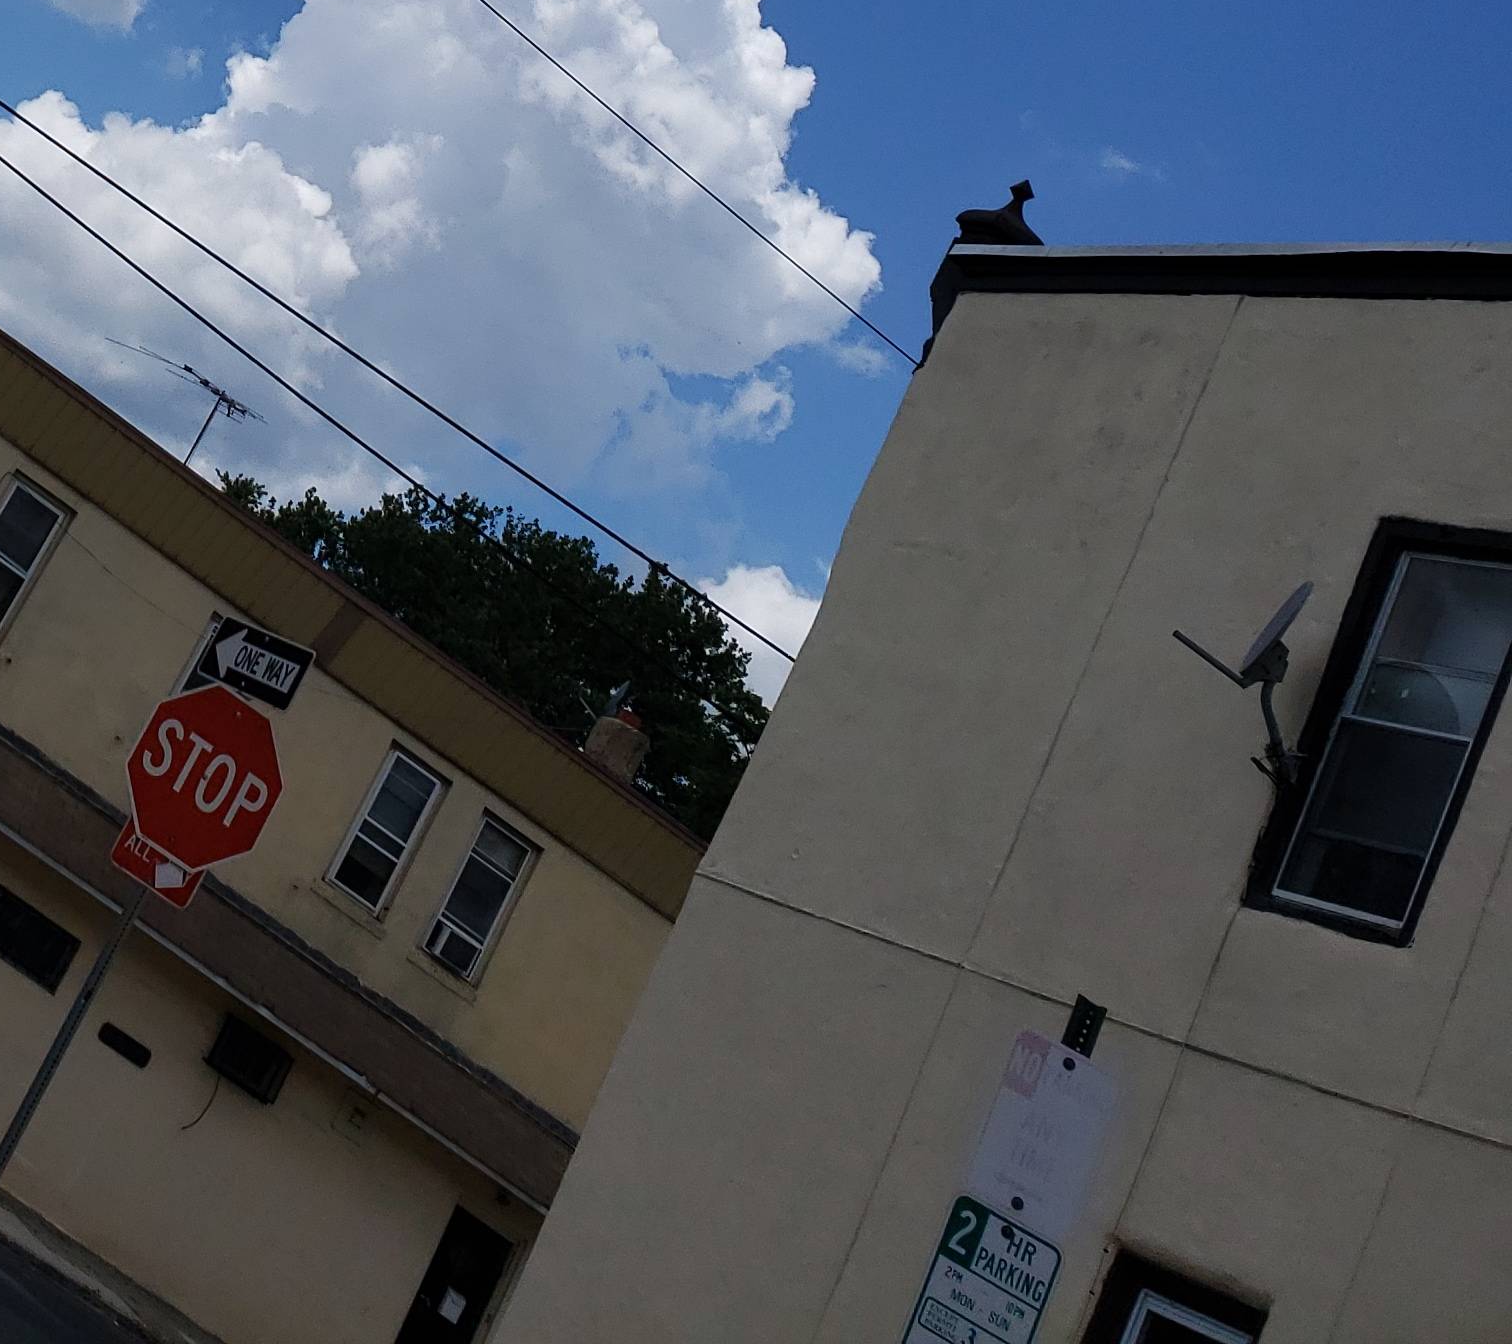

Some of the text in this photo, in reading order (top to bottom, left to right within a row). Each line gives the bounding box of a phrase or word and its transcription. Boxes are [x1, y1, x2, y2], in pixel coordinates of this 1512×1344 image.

[233, 645, 296, 689] ONE WAY
[143, 718, 269, 828] STOP
[124, 834, 152, 863] ALL
[948, 1209, 978, 1256] 2
[1006, 1232, 1037, 1266] HR
[974, 1246, 1046, 1303] PARKING
[950, 1287, 1010, 1332] MON SUN
